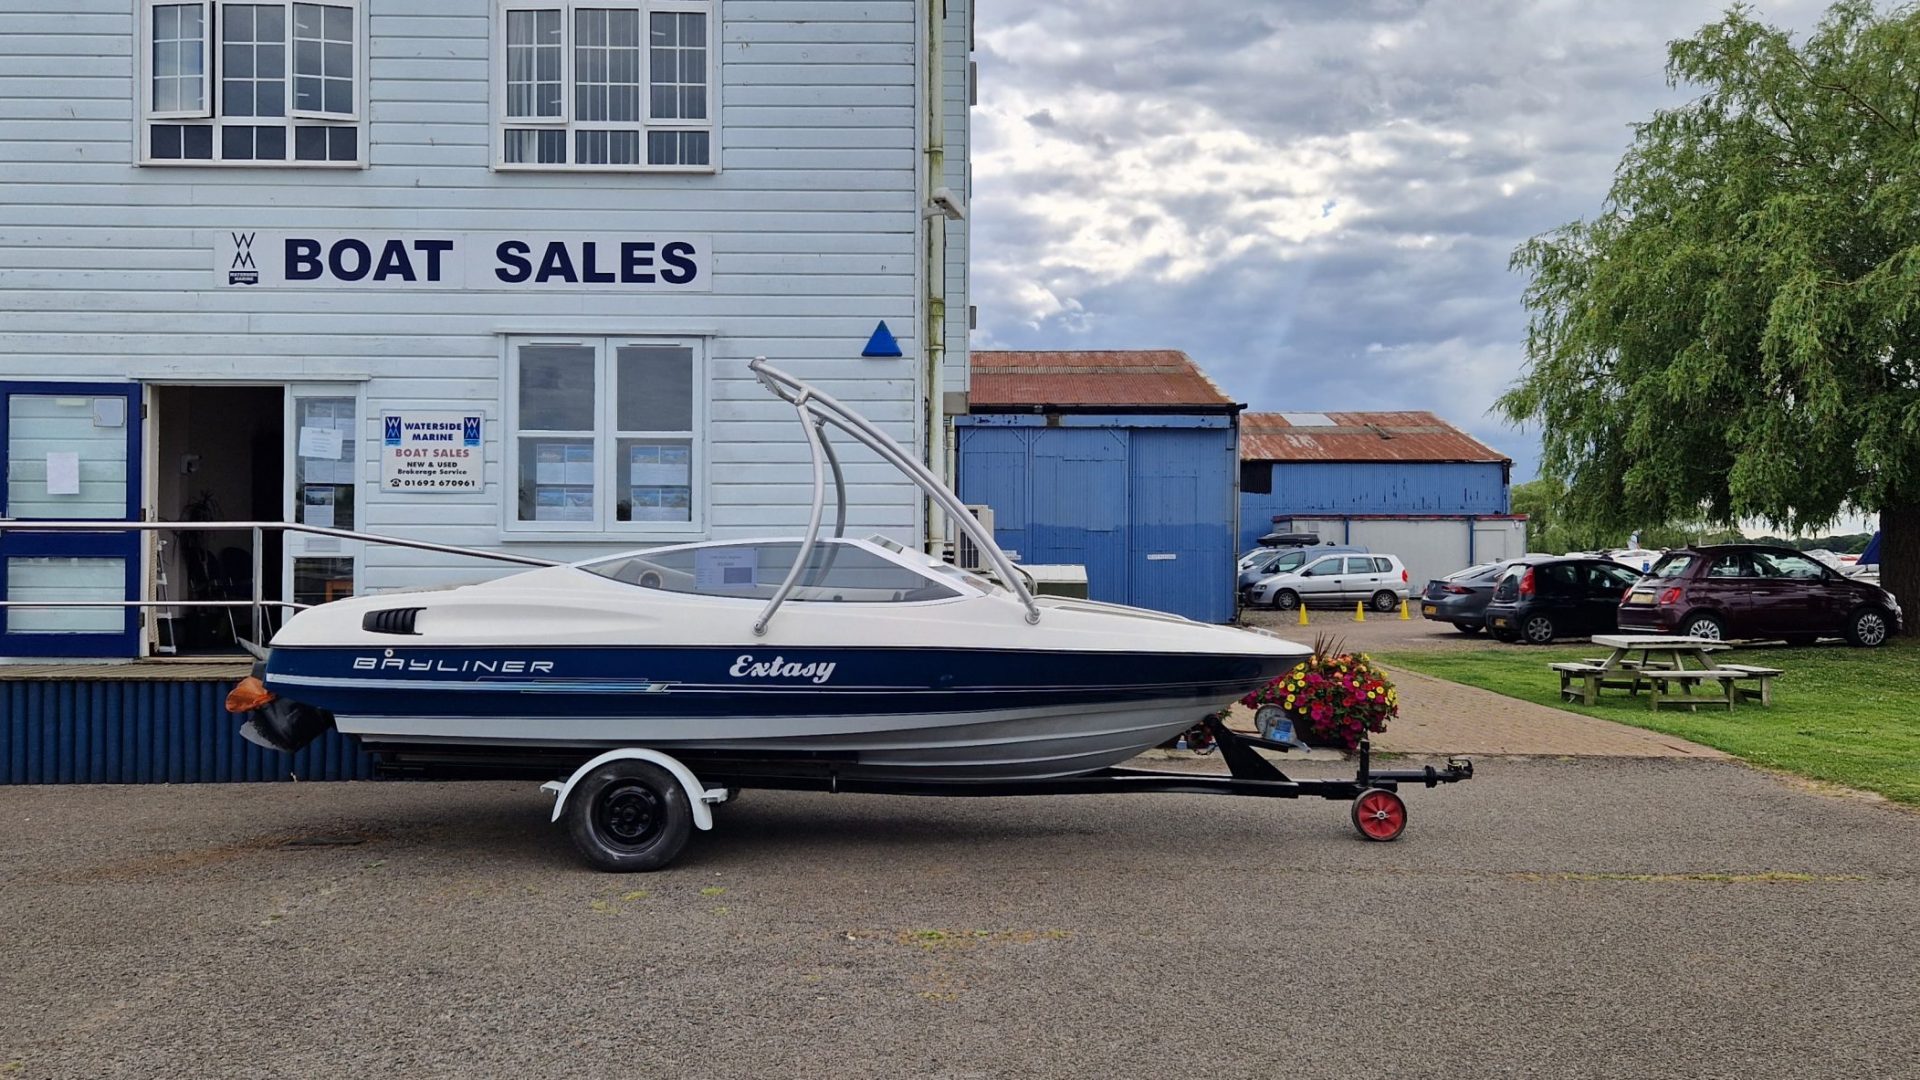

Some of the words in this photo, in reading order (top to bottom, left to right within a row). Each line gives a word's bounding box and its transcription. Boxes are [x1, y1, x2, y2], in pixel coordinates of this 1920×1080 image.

[284, 238, 454, 282] BOAT
[494, 240, 698, 284] SALES
[395, 449, 428, 457] BOAT
[433, 449, 469, 457] SALES
[353, 649, 554, 673] BAYLINER
[729, 654, 837, 684] Extasy
